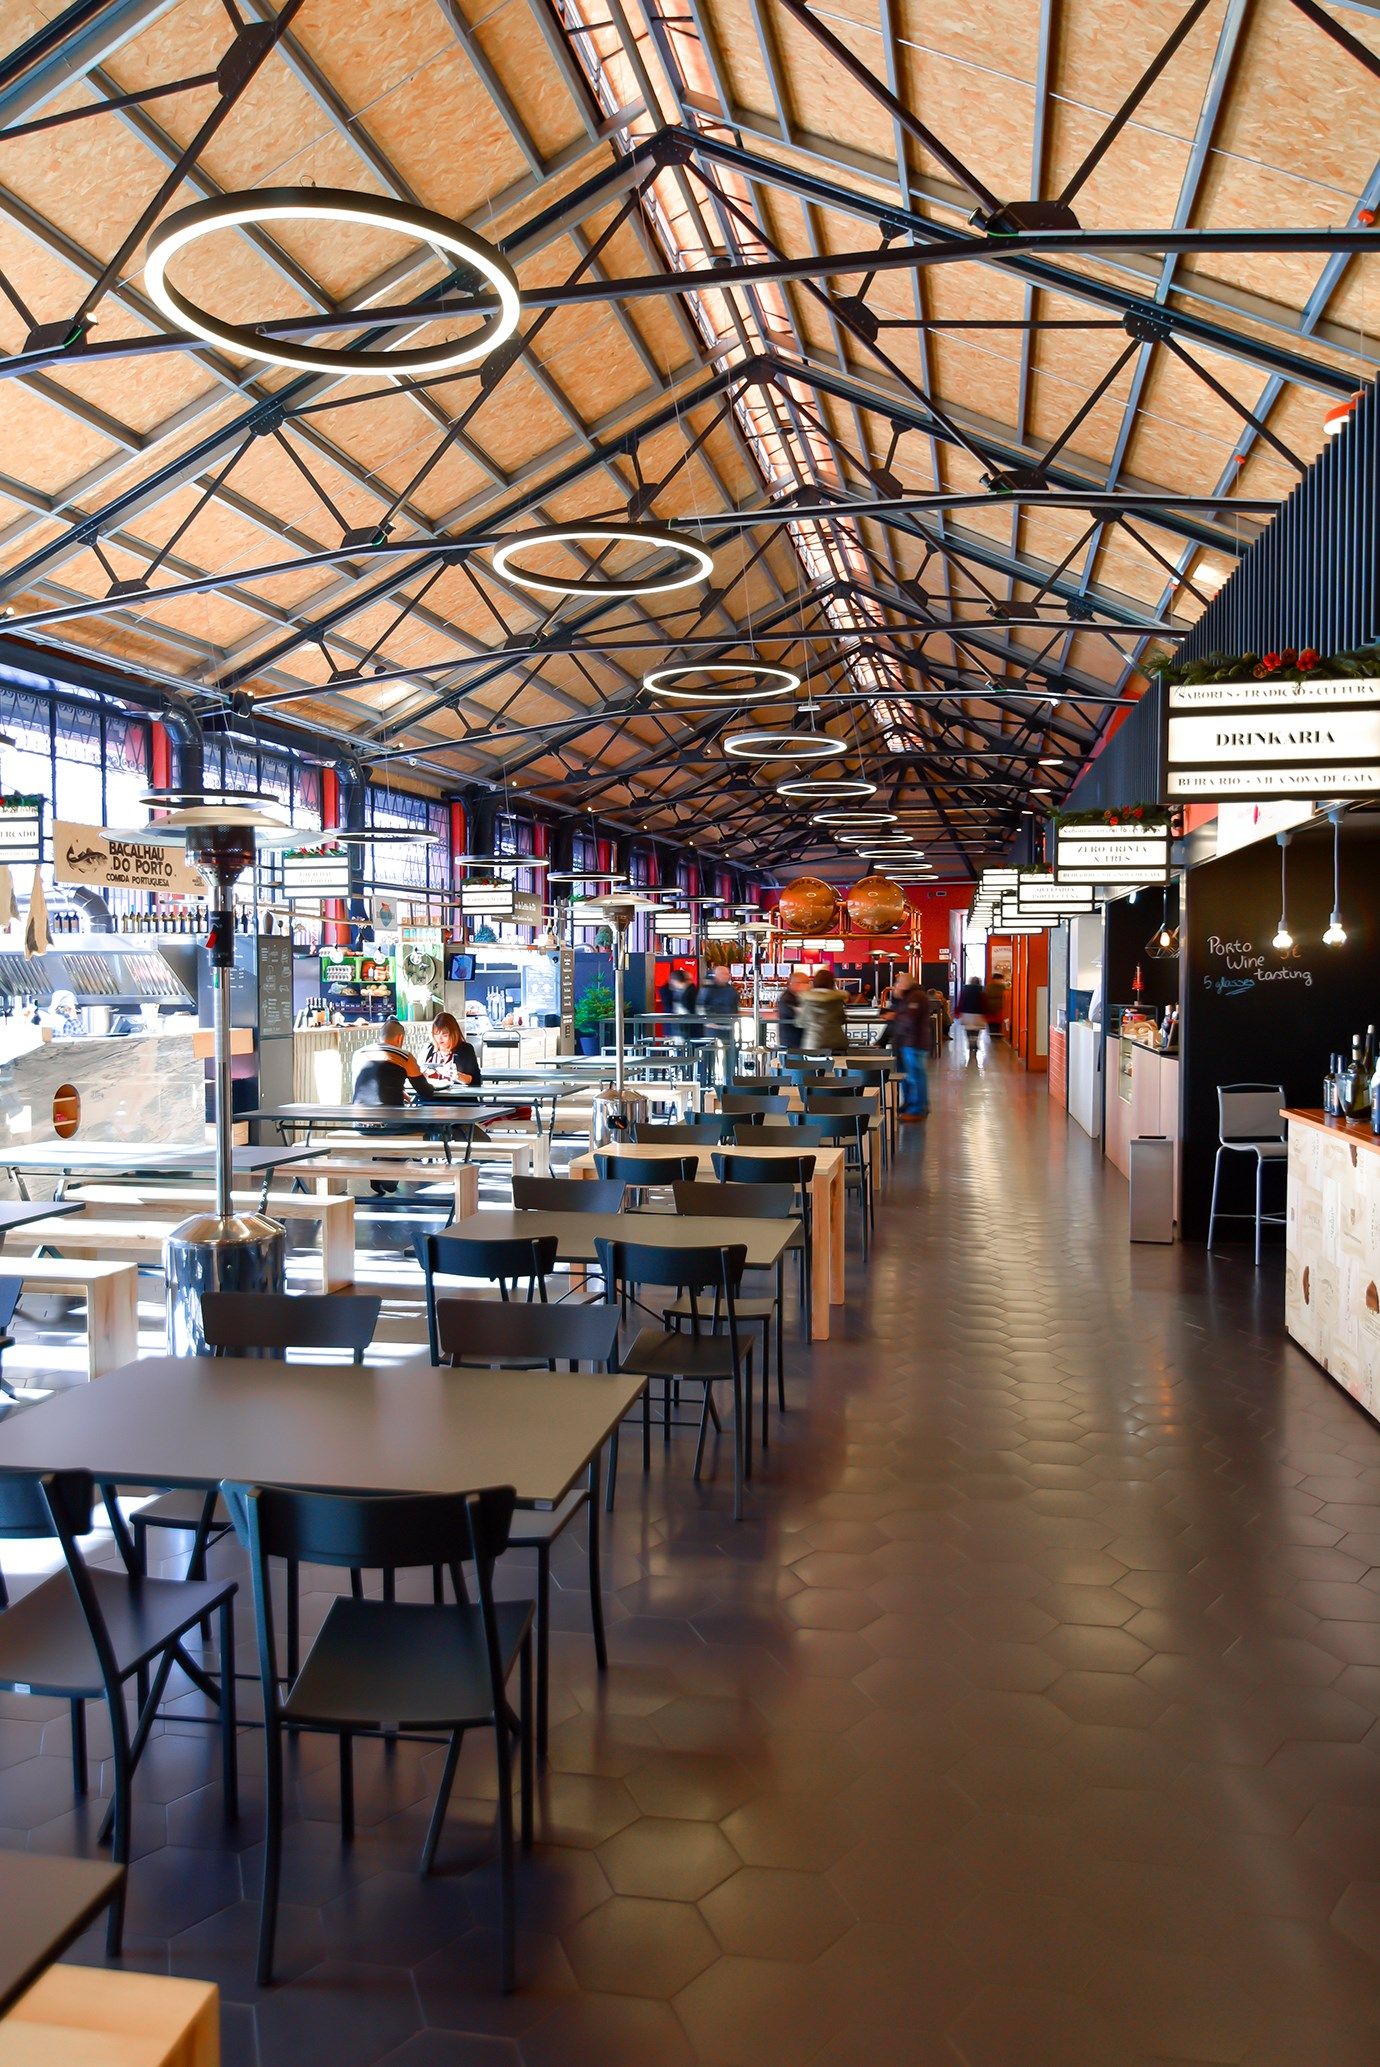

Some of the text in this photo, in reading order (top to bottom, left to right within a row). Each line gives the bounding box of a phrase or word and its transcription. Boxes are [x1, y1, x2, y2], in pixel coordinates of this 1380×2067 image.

[1178, 690, 1233, 700] SABORES
[1317, 685, 1375, 696] CULTURA
[1216, 730, 1335, 747] DRINKARIA
[1178, 778, 1215, 787] BEIRA
[1219, 777, 1241, 786] RIO
[1256, 776, 1284, 785] VILA
[1289, 775, 1319, 784] NOVA
[1323, 774, 1337, 783] DE
[109, 841, 165, 862] BACALHAU
[112, 857, 173, 877] DO PORTO
[106, 873, 170, 888] COMIDA PORTUGUESA
[1226, 955, 1265, 970] Wine
[1203, 975, 1256, 994] 5 glasses
[1254, 967, 1313, 987] tasting
